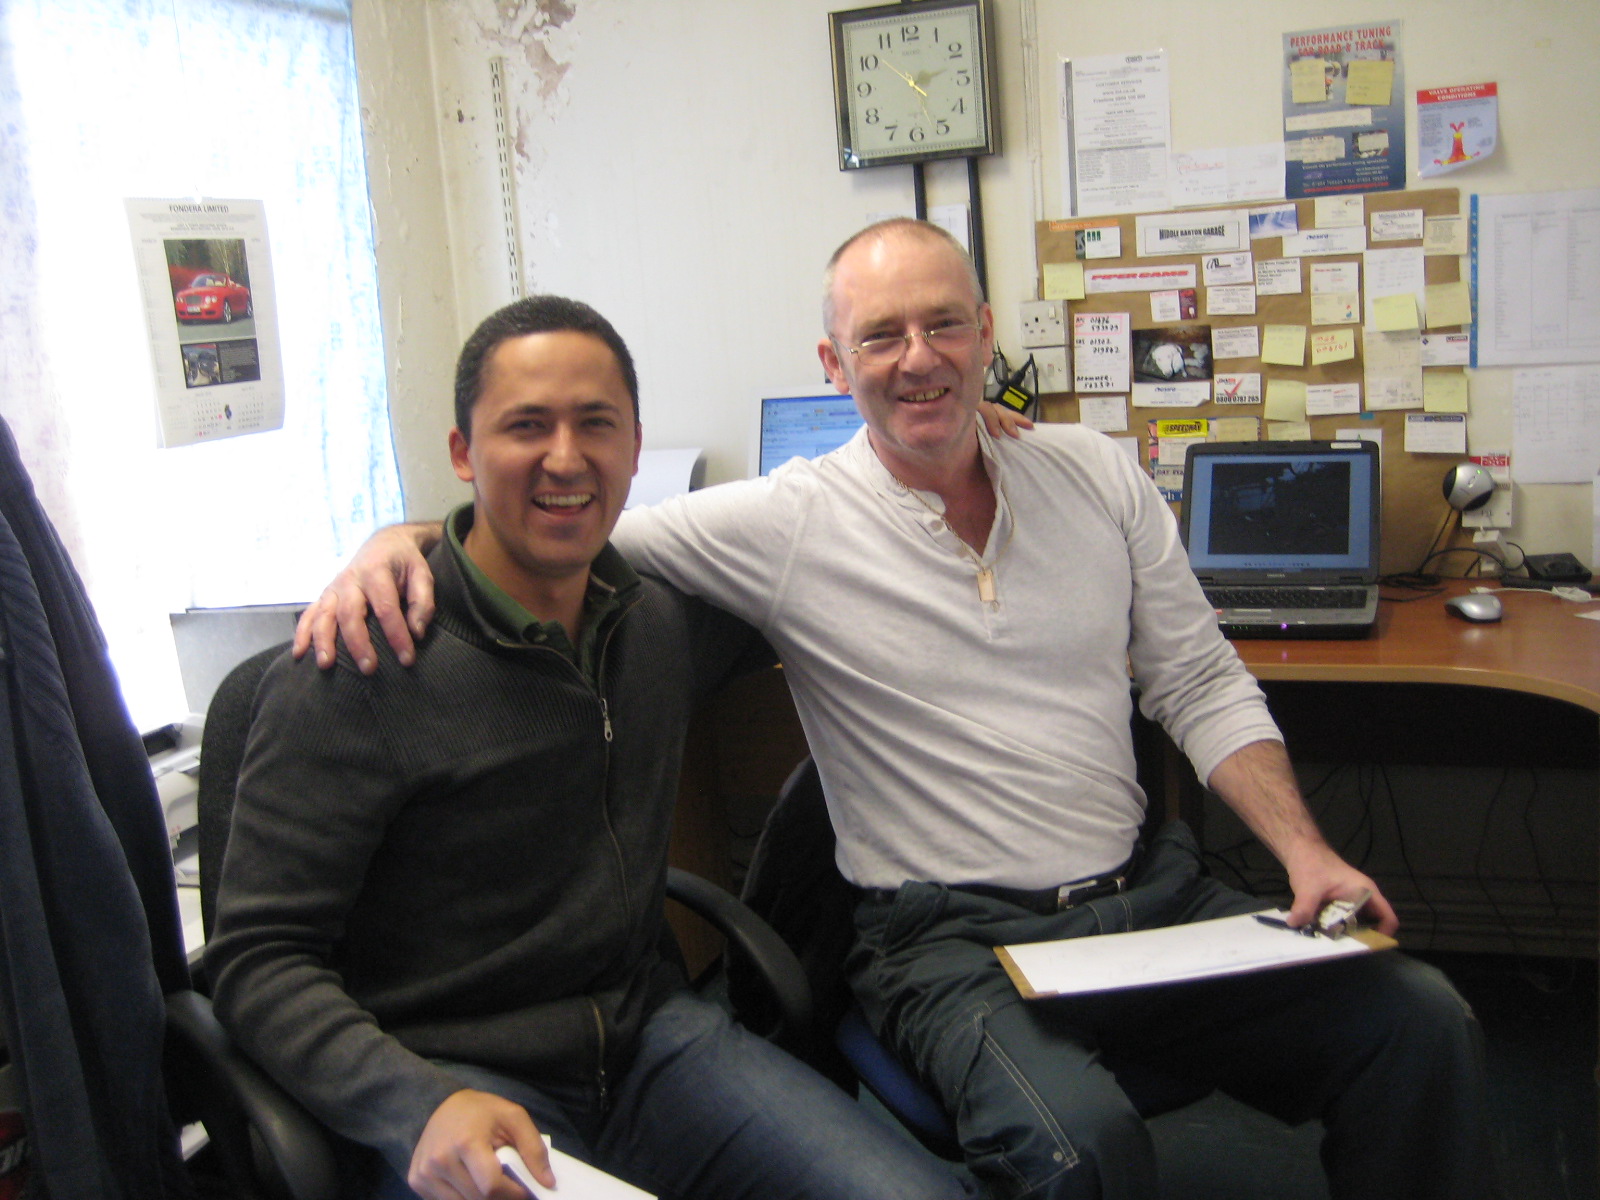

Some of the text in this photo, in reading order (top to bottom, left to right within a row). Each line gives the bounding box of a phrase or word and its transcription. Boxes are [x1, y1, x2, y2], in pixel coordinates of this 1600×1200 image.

[878, 32, 891, 50] 11
[901, 25, 920, 42] 12
[934, 27, 939, 43] 1
[1290, 26, 1391, 48] PERFORMANCE TUNING
[948, 42, 963, 59] 2
[1318, 44, 1342, 54] ROAD
[1355, 39, 1385, 52] TRACK
[860, 54, 879, 72] 10
[956, 69, 970, 87] 3
[857, 82, 872, 98] 9
[1437, 92, 1476, 101] CONDITIONS
[1449, 84, 1485, 93] OPERATING
[951, 97, 965, 115] 4
[865, 108, 880, 125] 8
[884, 125, 898, 141] 7
[909, 126, 925, 143] 6
[936, 119, 950, 136] 5
[203, 205, 229, 213] LIMITED
[1159, 228, 1179, 240] MIDDLE
[1203, 225, 1225, 236] GARAGE
